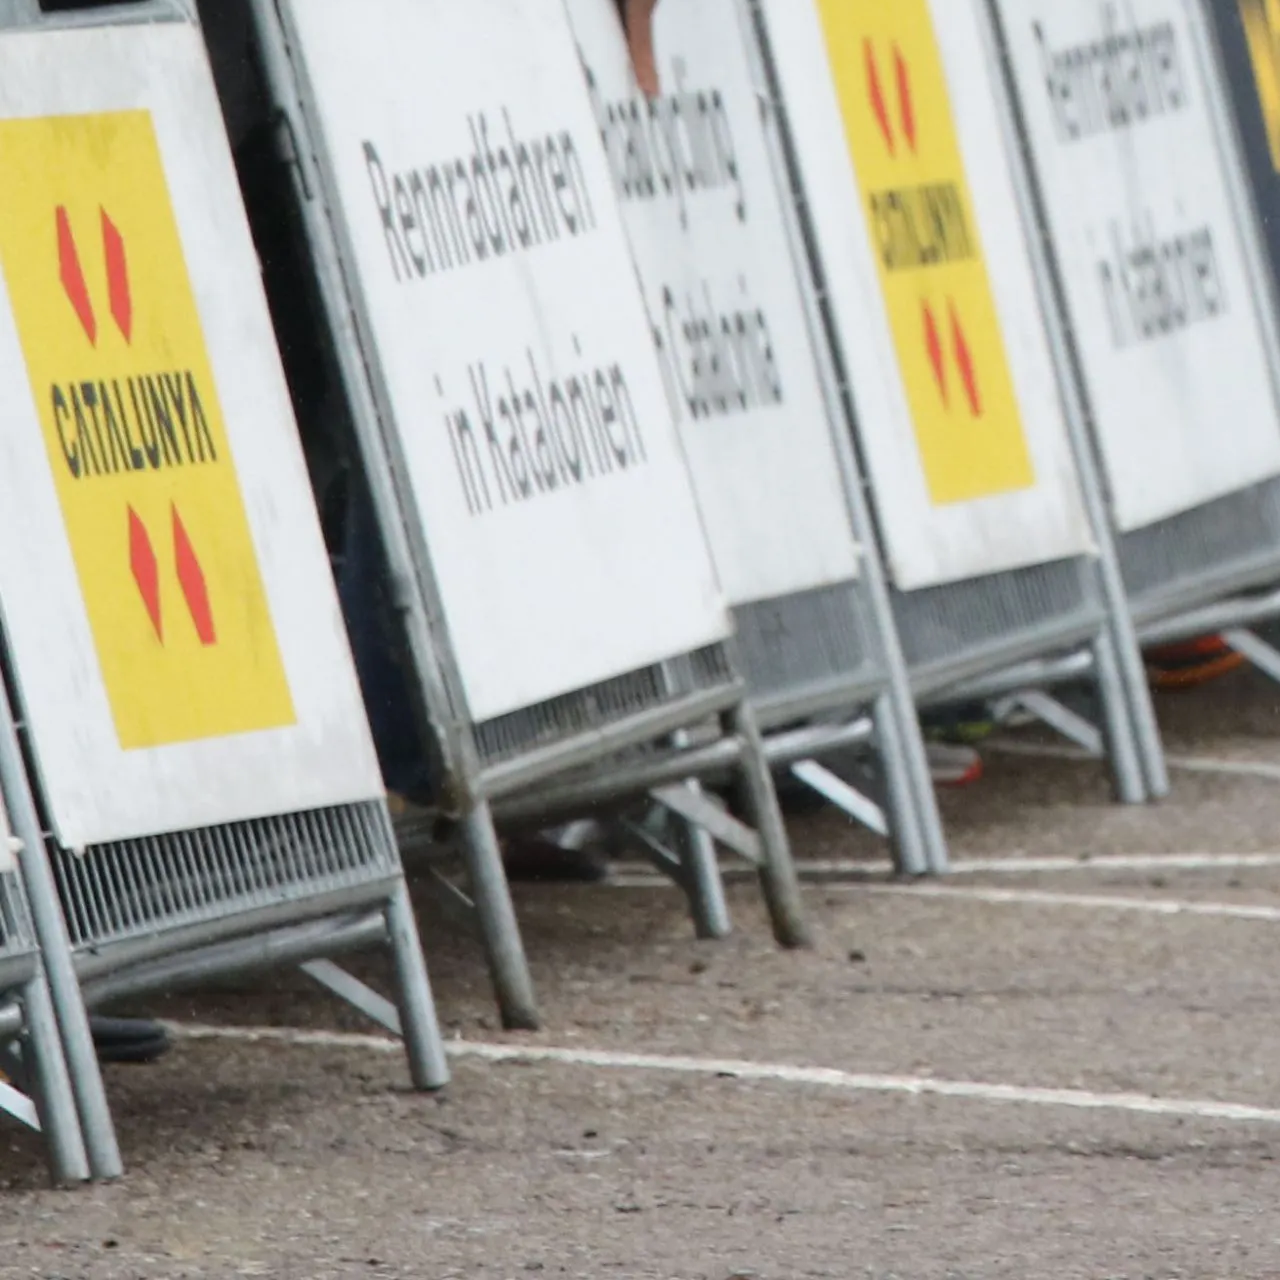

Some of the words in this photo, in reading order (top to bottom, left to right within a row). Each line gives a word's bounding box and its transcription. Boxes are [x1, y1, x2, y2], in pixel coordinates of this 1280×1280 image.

[362, 105, 597, 284] Rennradfahren
[50, 370, 217, 480] CATALUNYA
[434, 372, 493, 517] in
[468, 331, 648, 507] Katalonien
